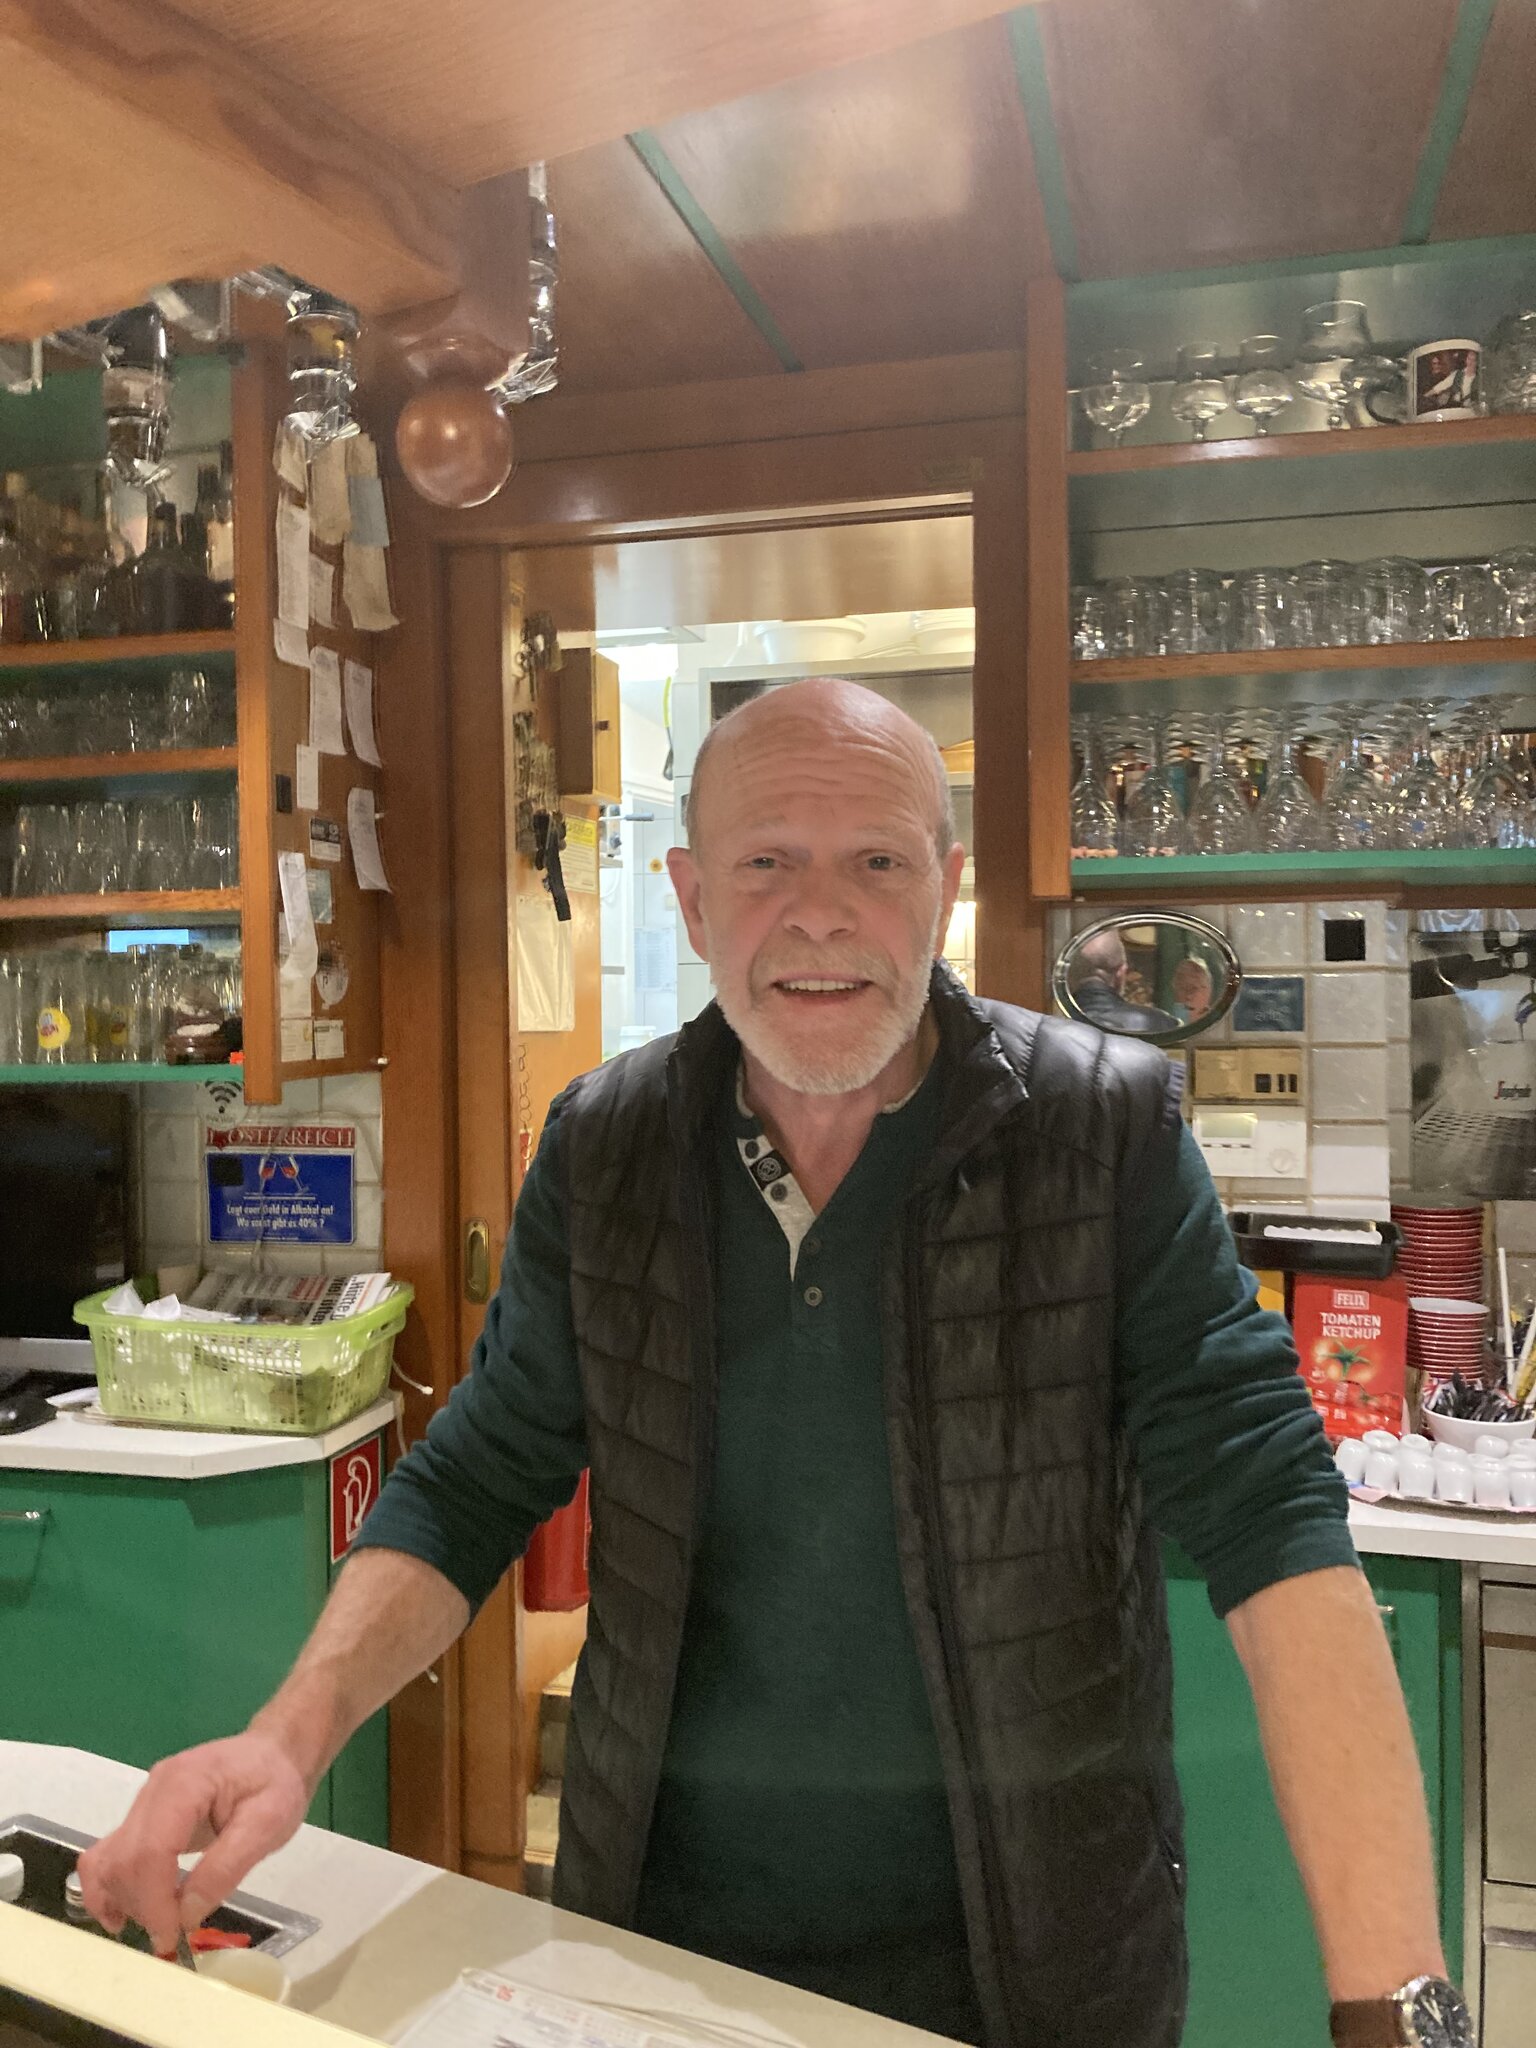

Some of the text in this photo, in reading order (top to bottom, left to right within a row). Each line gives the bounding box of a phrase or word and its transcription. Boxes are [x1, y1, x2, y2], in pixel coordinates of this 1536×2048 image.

[290, 1204, 319, 1215] Alkohol
[272, 1217, 286, 1230] gibt
[298, 1217, 317, 1229] 40%
[1337, 1291, 1366, 1308] FELIX
[1320, 1311, 1382, 1328] TOMATEN
[1322, 1325, 1382, 1340] KETCHUP
